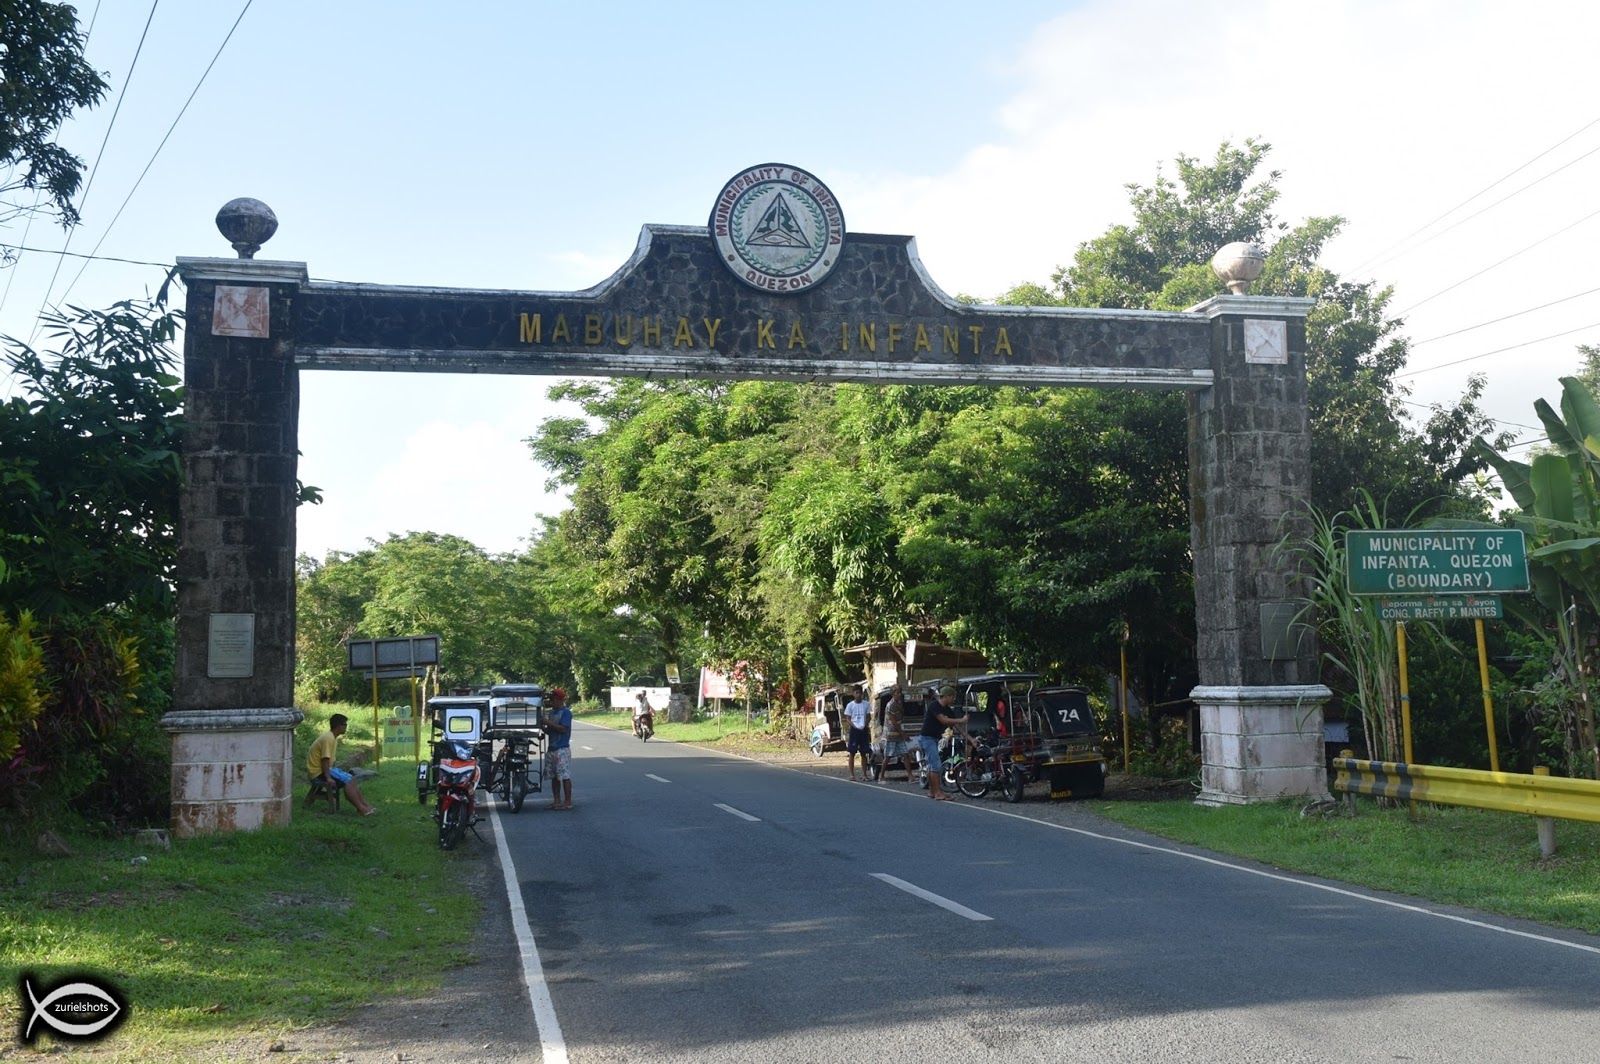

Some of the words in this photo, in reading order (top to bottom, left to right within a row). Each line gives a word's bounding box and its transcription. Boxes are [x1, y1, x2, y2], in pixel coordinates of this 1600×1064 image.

[714, 168, 784, 237] MUNICIPALITY
[790, 171, 810, 186] OF
[811, 184, 842, 246] INFANTA
[745, 270, 814, 291] QUEZON
[519, 312, 721, 348] MABUHAY
[757, 319, 808, 349] KA
[841, 321, 1013, 356] INFANTA
[1369, 537, 1477, 552] MUNICIPALITY
[1486, 536, 1504, 551] OF
[1450, 554, 1513, 568] QUEZON
[1388, 571, 1493, 590] (BOUNDARY)
[1466, 595, 1496, 608] Nayon
[1382, 608, 1411, 619] CONG.
[1415, 608, 1445, 618] RAFFY
[1449, 607, 1458, 618] P.
[1460, 606, 1497, 618] NANTES
